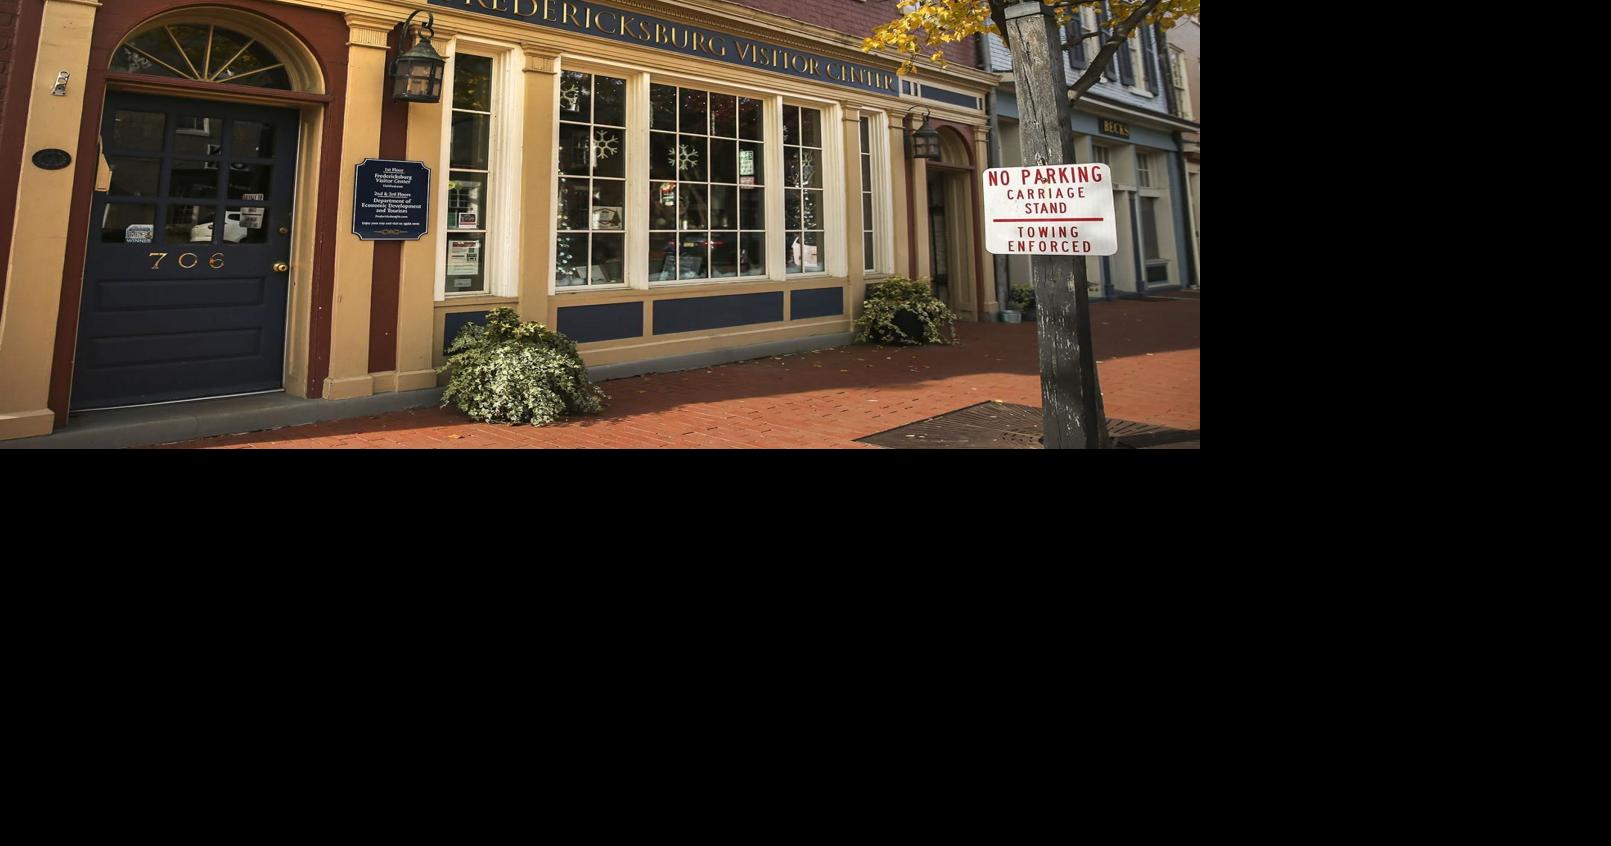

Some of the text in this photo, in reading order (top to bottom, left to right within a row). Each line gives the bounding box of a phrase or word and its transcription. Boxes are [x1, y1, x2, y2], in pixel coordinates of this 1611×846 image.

[446, 0, 897, 91] EDERICKSBURG VISITOR CENTER
[988, 165, 1103, 187] NO PARKING
[1007, 187, 1086, 200] CARRIAGE
[1025, 202, 1067, 214] STAND
[1018, 226, 1079, 238] TOWING
[1008, 240, 1091, 253] ENFORCED
[148, 252, 225, 270] 706
